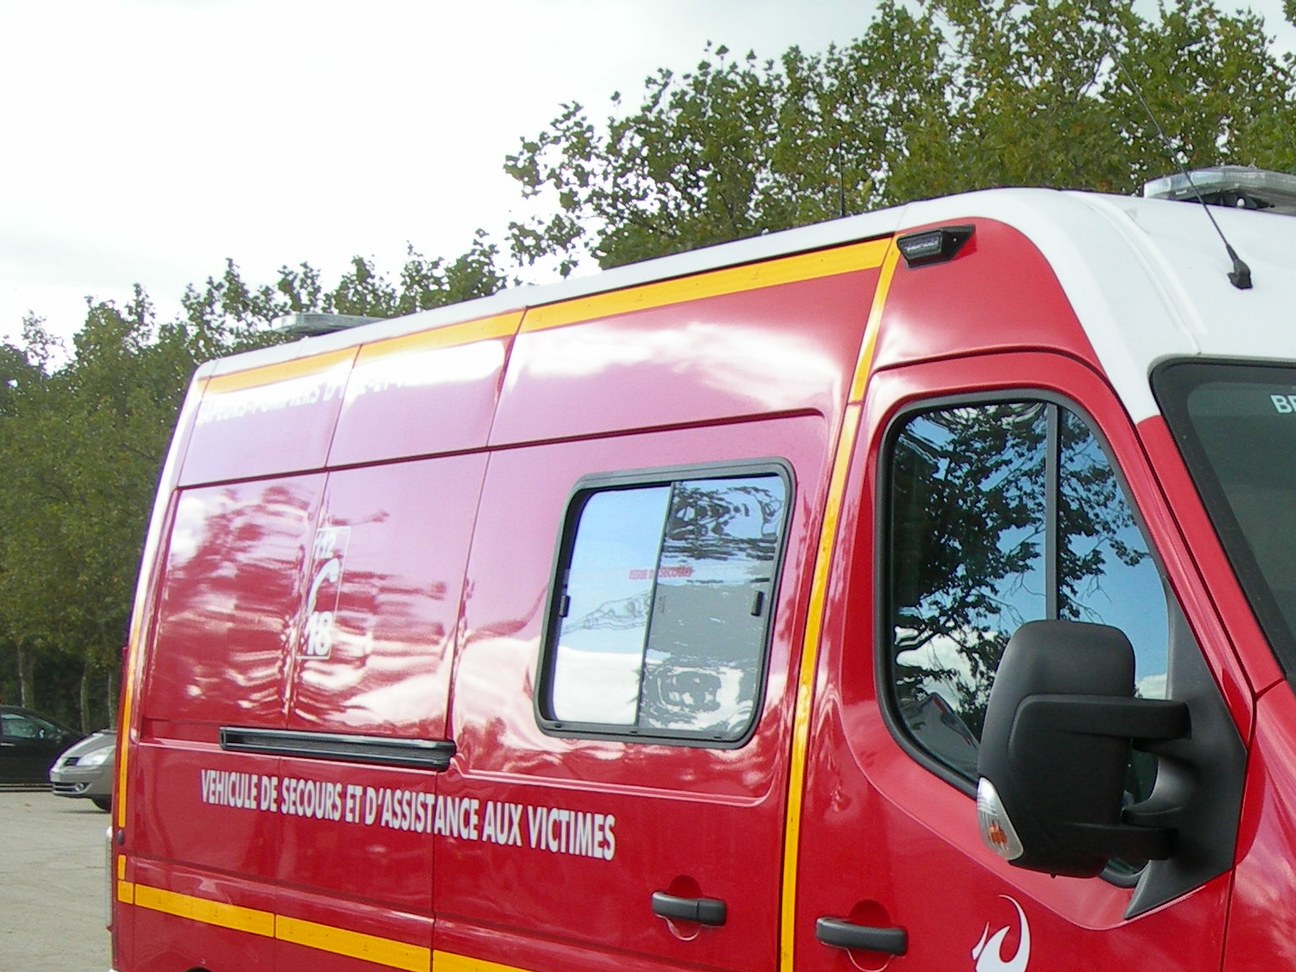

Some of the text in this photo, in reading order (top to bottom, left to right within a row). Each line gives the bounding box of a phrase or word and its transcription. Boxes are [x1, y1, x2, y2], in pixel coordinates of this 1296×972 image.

[304, 611, 333, 655] 18
[201, 769, 616, 861] VEHICULE DE SECOURS ET D'ASSISTANCE AUX VICTIMES
